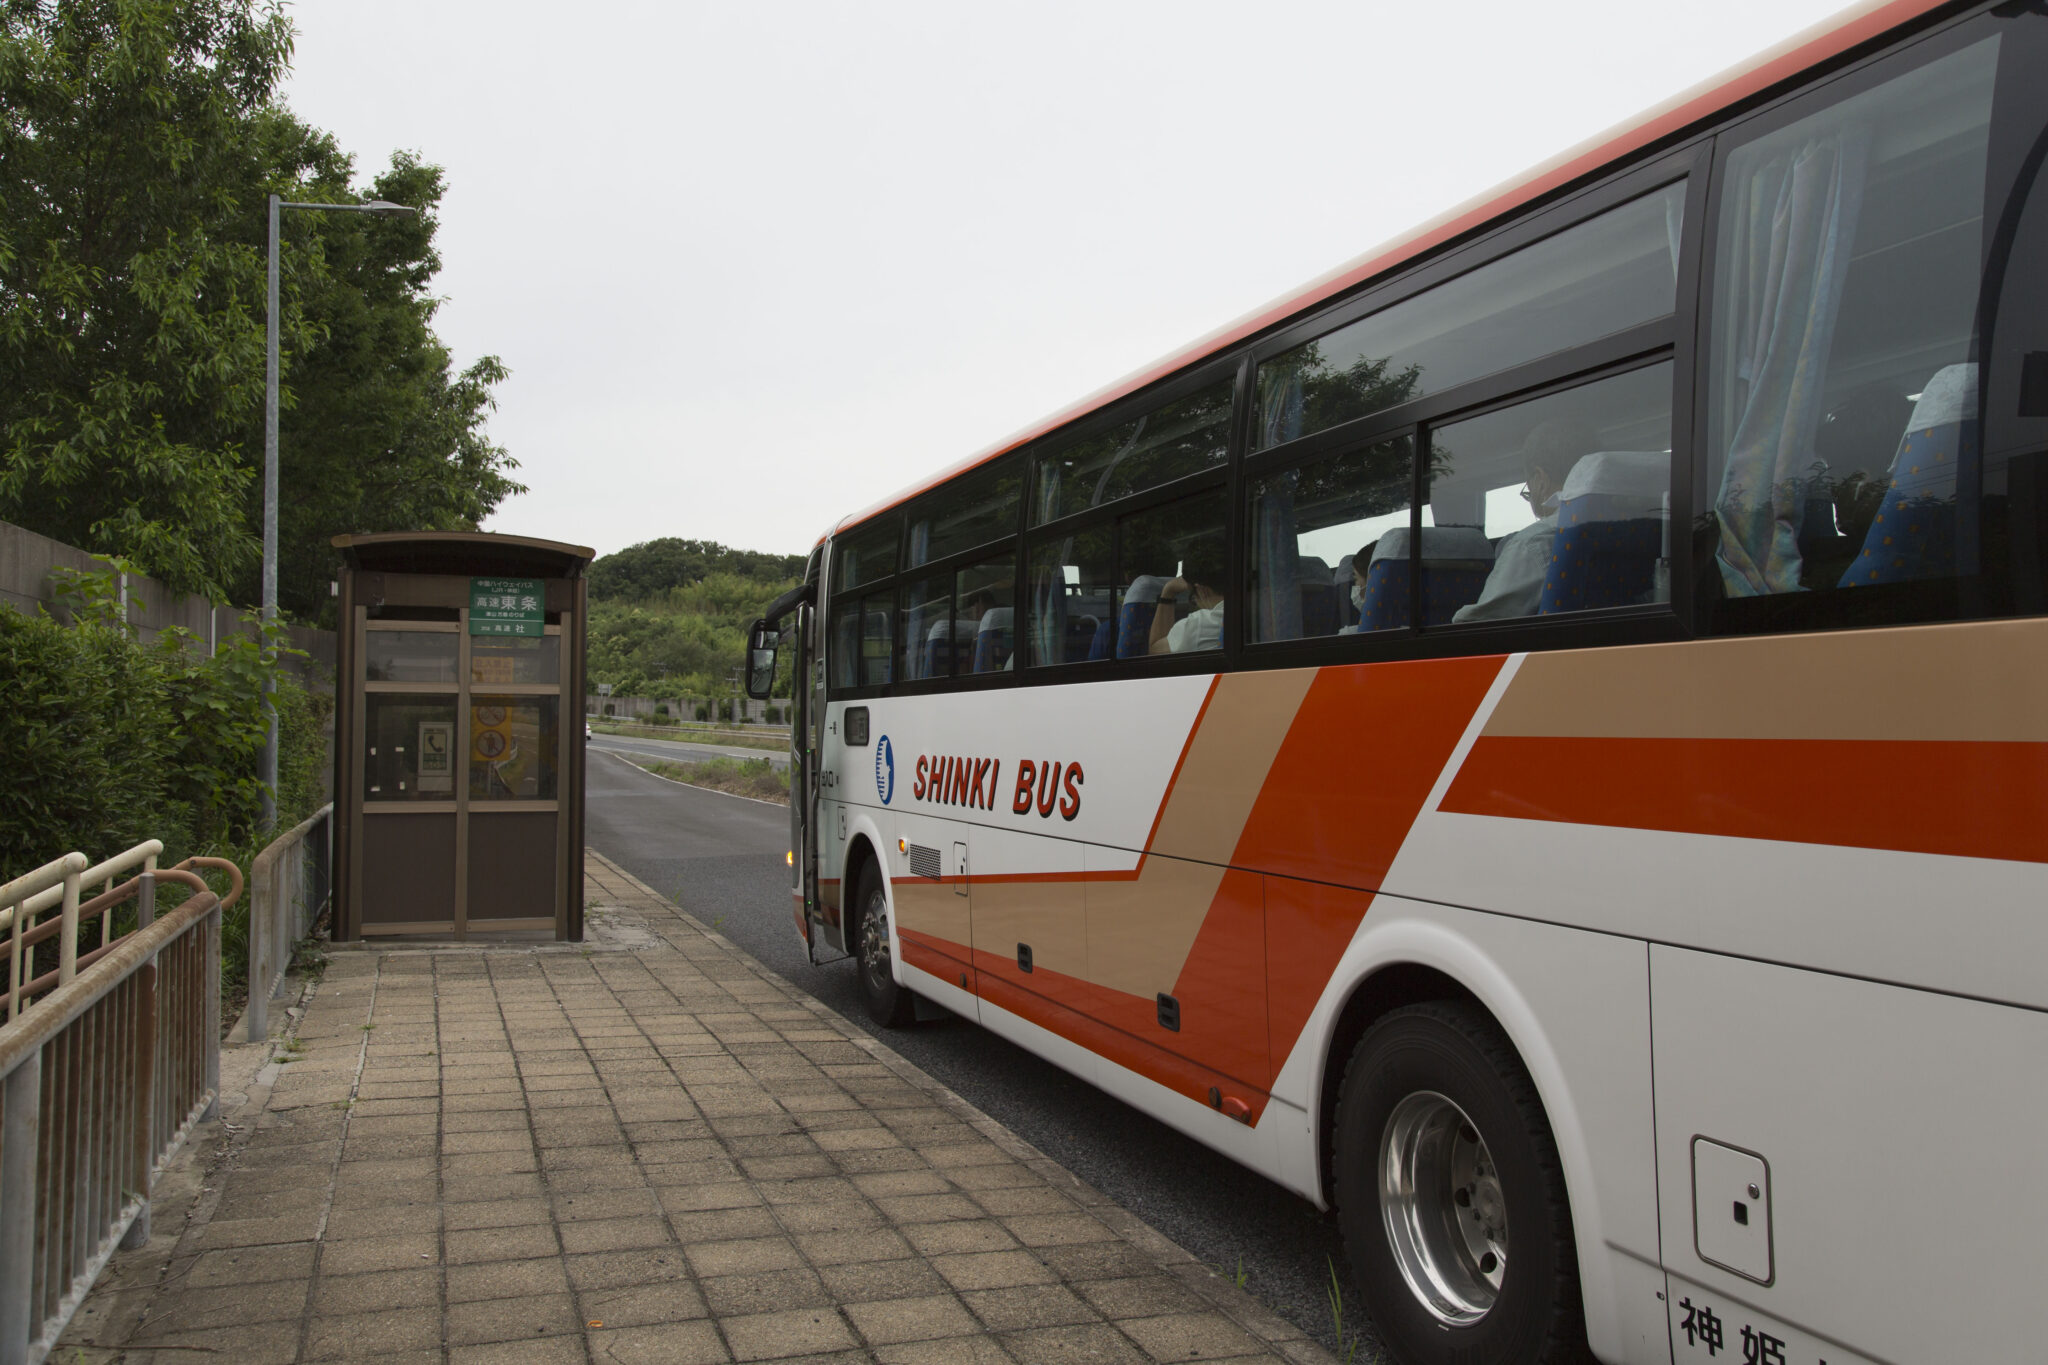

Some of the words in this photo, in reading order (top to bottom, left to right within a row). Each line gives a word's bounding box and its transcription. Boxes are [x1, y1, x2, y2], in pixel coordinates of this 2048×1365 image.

[913, 754, 1000, 811] SHINKI
[1012, 759, 1084, 822] BUS
[1678, 1296, 1828, 1365] 神姫
